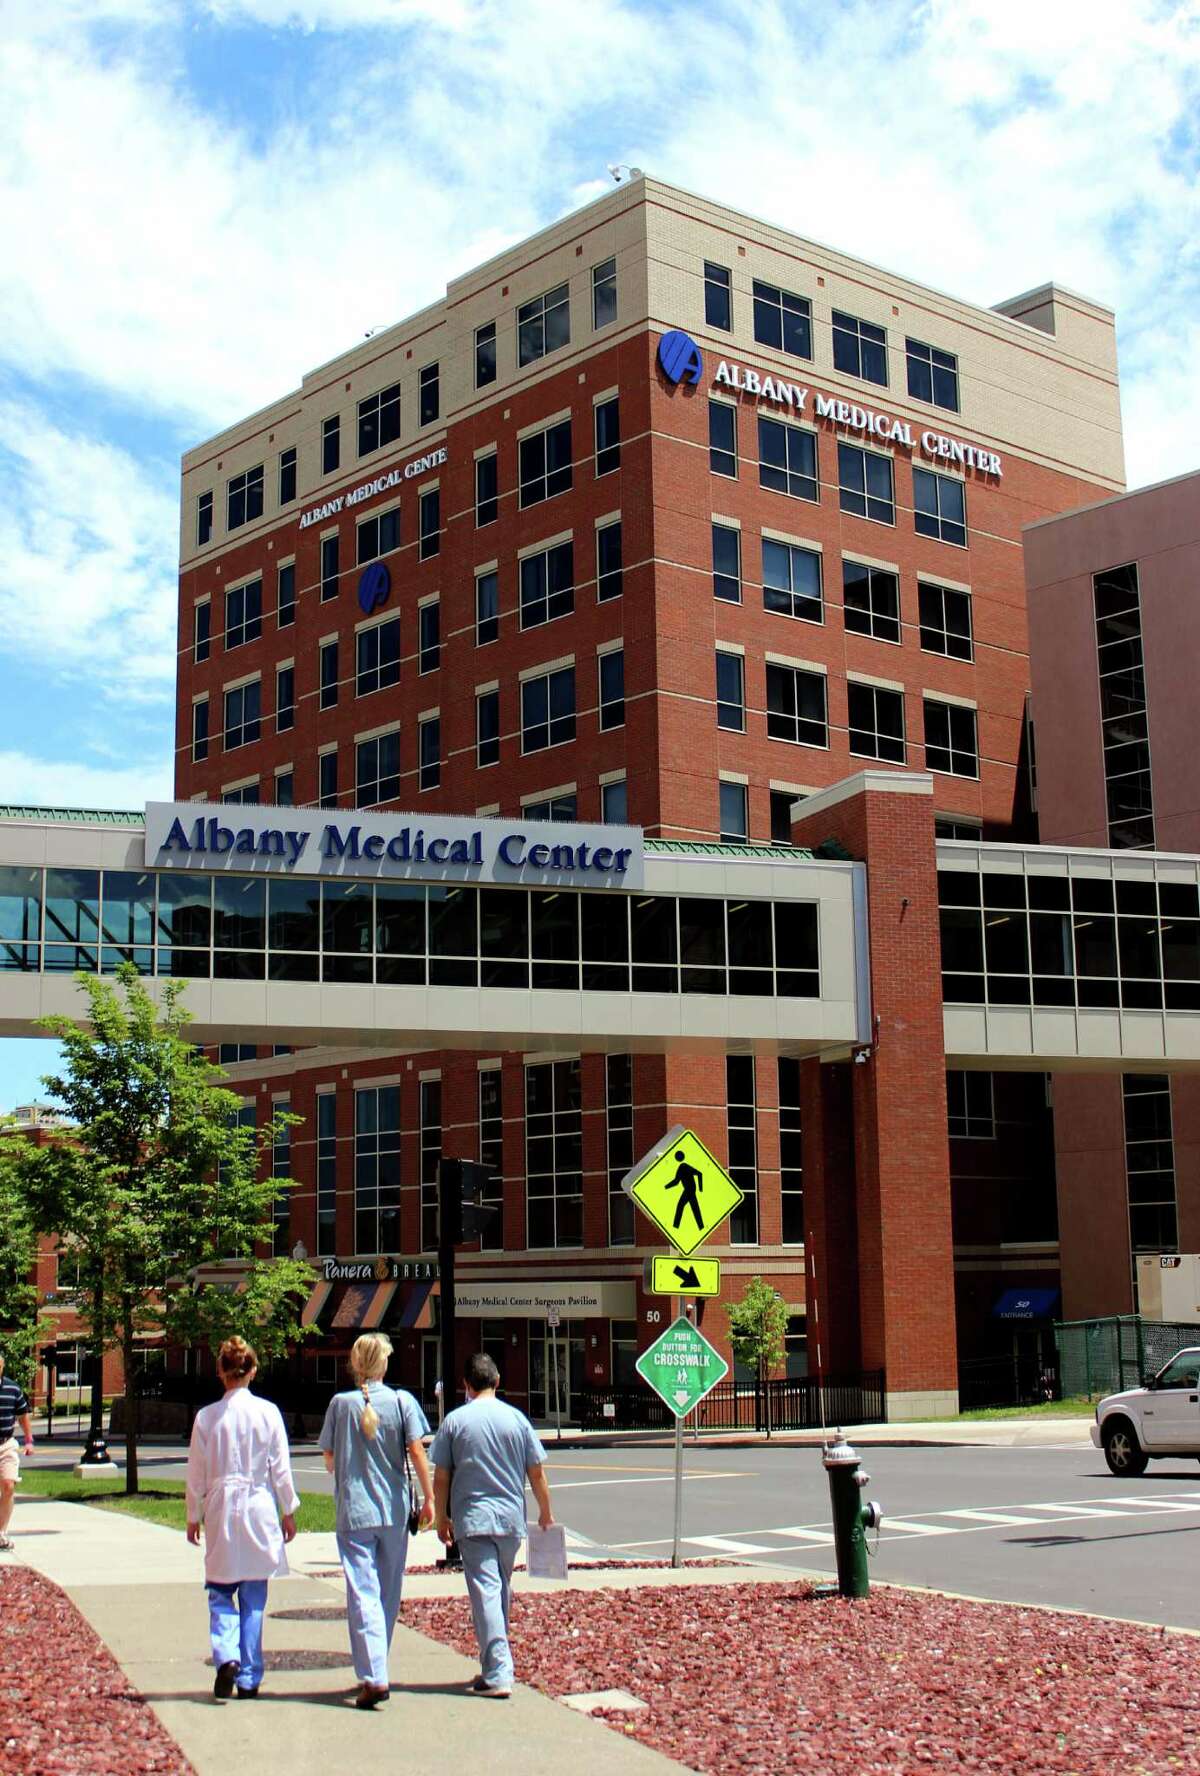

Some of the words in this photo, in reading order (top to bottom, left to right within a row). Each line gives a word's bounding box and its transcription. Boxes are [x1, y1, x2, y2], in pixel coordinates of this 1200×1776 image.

[714, 360, 808, 410] ALBANY
[815, 394, 916, 448] MEDICAL
[922, 431, 1003, 476] CENTER
[299, 496, 345, 529] ALBANY
[345, 470, 402, 507] MEDICAL
[404, 447, 448, 479] CENTE
[159, 816, 310, 865] Albany
[324, 824, 484, 866] Medical
[499, 834, 633, 873] Center
[323, 1258, 372, 1280] Panera
[1161, 1258, 1175, 1268] CAT
[457, 1297, 480, 1308] Albany
[481, 1297, 508, 1306] Medical
[510, 1297, 533, 1306] Center
[535, 1297, 566, 1309] Surgeons
[569, 1296, 598, 1306] Pavilion
[647, 1311, 660, 1323] 50
[674, 1332, 691, 1341] PUSH
[662, 1343, 687, 1351] BUTTON
[690, 1344, 703, 1352] FOR
[654, 1353, 710, 1367] CROSSWALK
